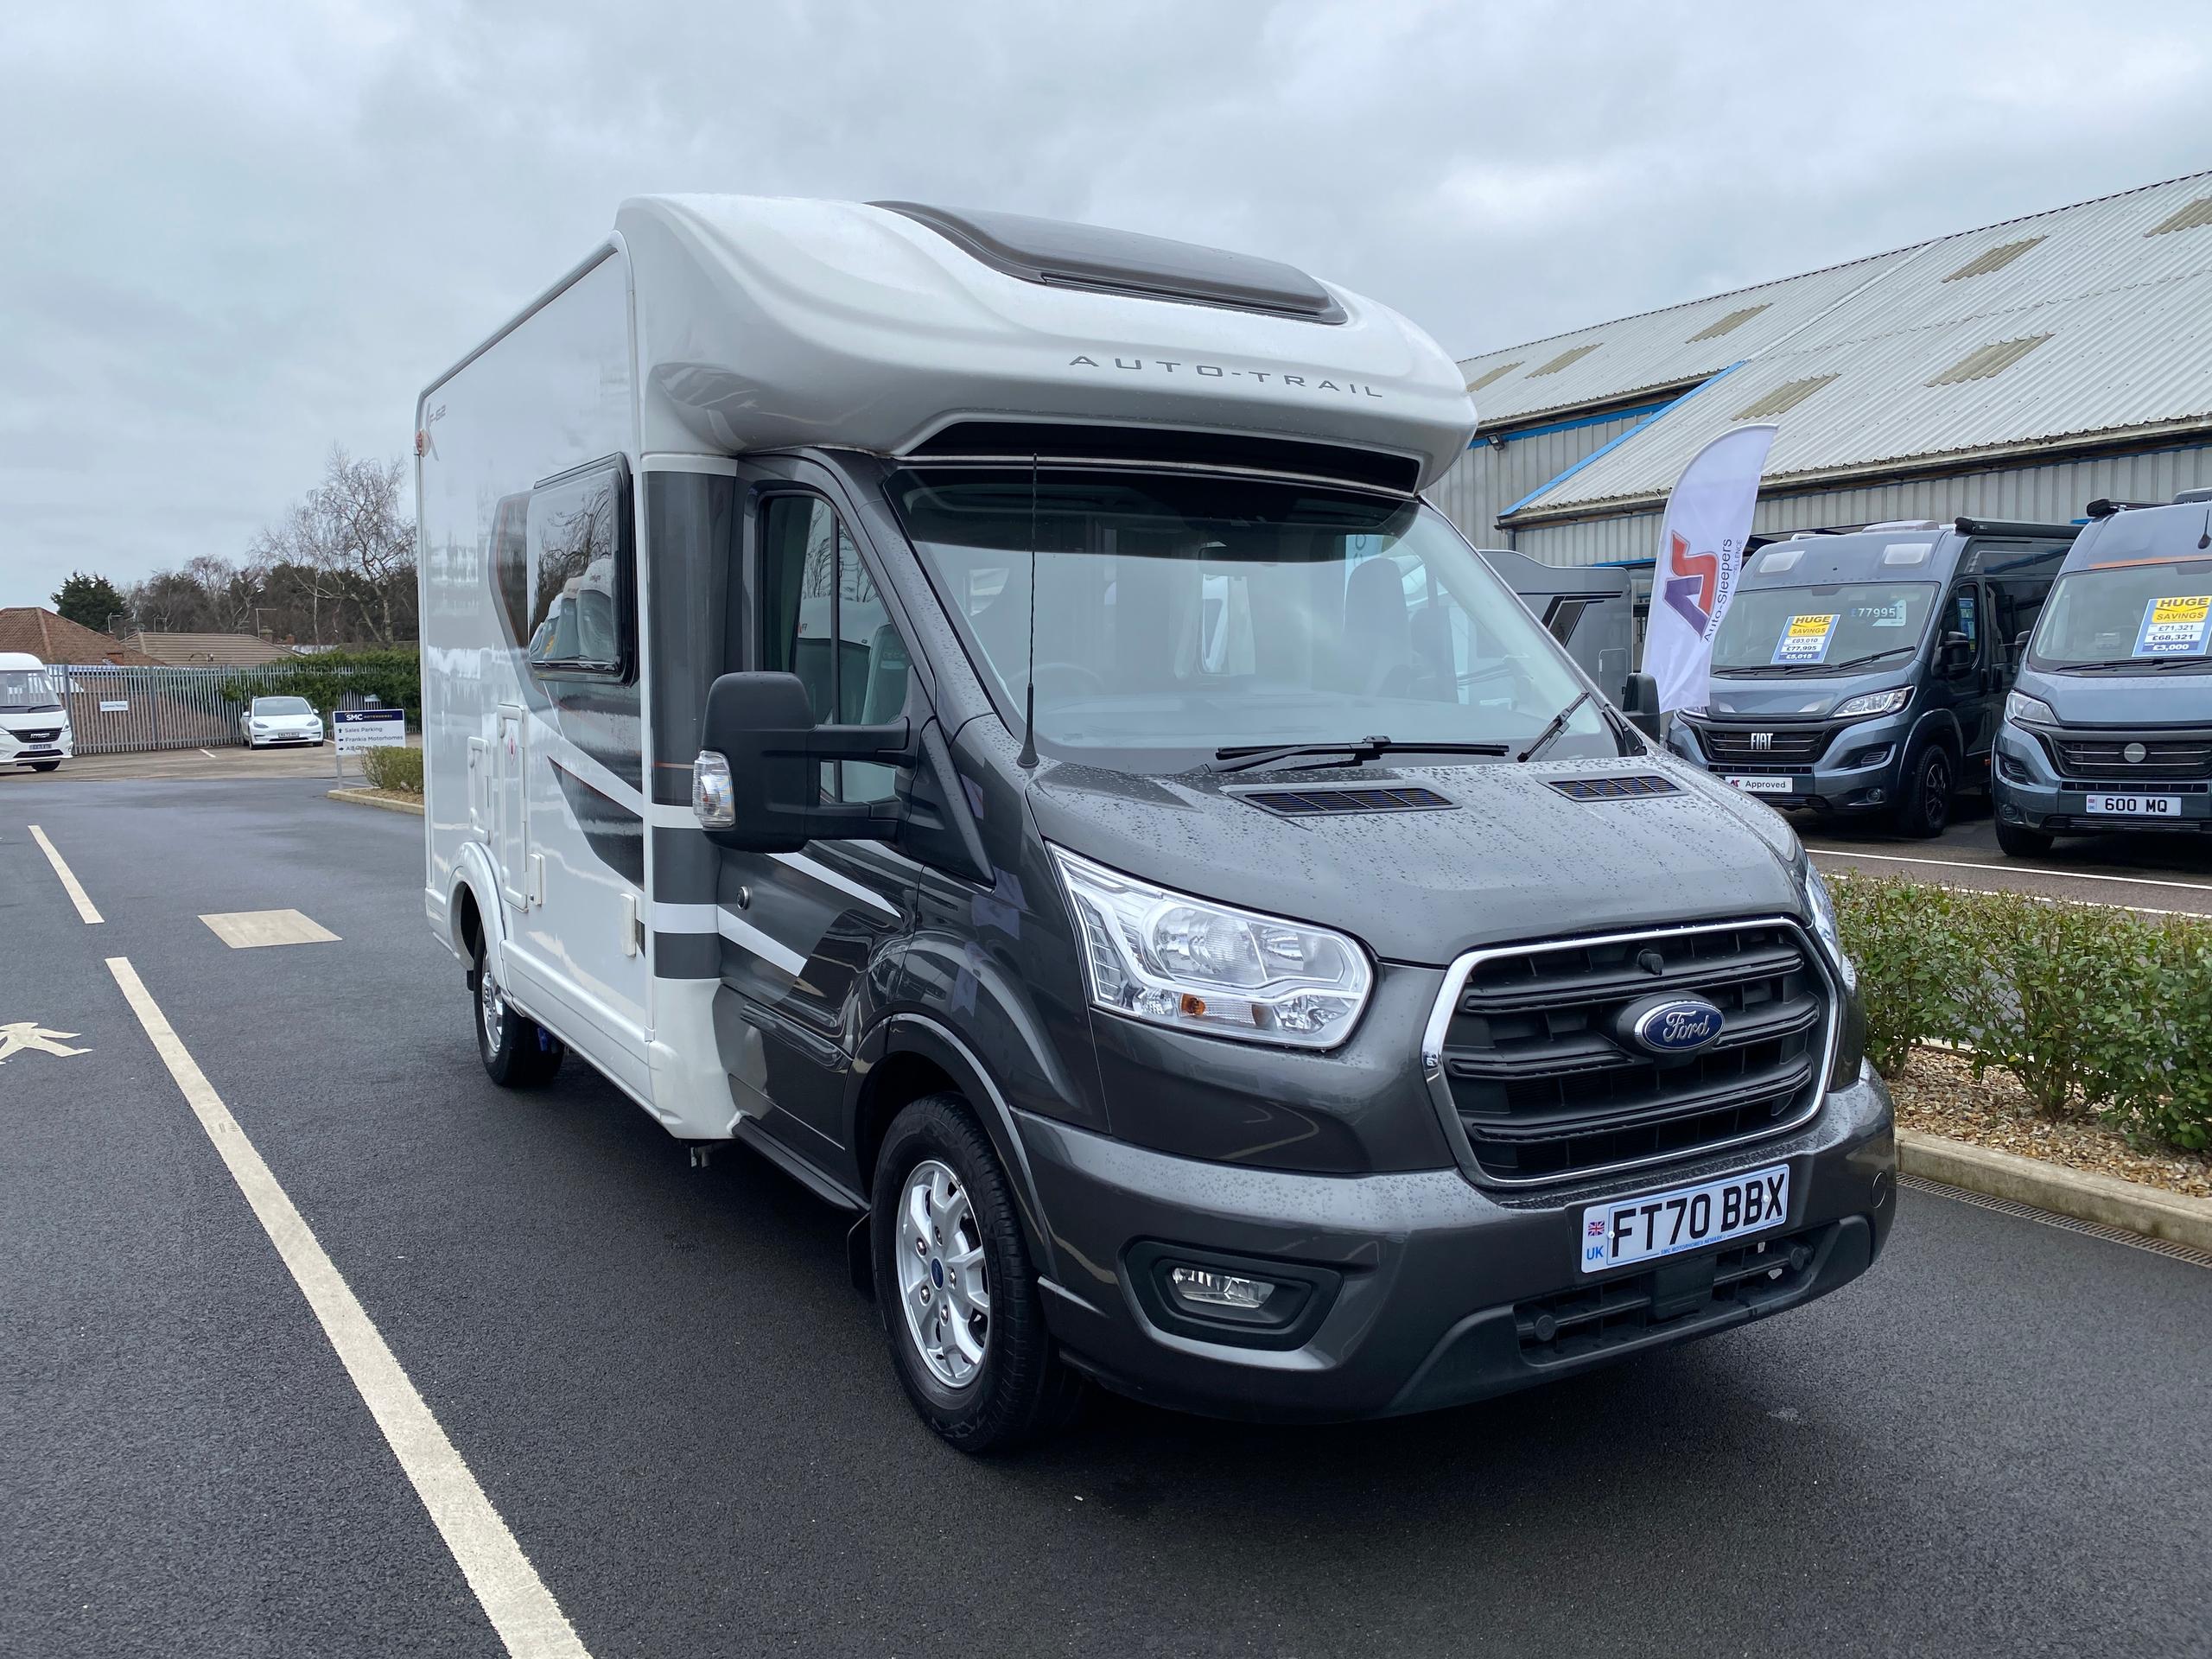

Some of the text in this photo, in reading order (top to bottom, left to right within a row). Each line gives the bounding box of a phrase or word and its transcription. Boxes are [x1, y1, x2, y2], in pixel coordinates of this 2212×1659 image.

[1069, 355, 1382, 397] AUTO-TRAIL
[1704, 538, 1732, 641] Auto-Sleepers
[2160, 597, 2209, 607] HUGE
[1851, 607, 1896, 617] £77995
[2157, 612, 2204, 620] SAVINGS
[1795, 615, 1831, 624] HUGE
[1751, 733, 1773, 750] FIAT
[1745, 780, 1786, 789] Approved
[2105, 798, 2168, 812] 600 MQ
[1662, 1010, 1710, 1043] Ford
[1611, 1173, 1785, 1258] FT70 BBX
[1586, 1245, 1604, 1260] UK
